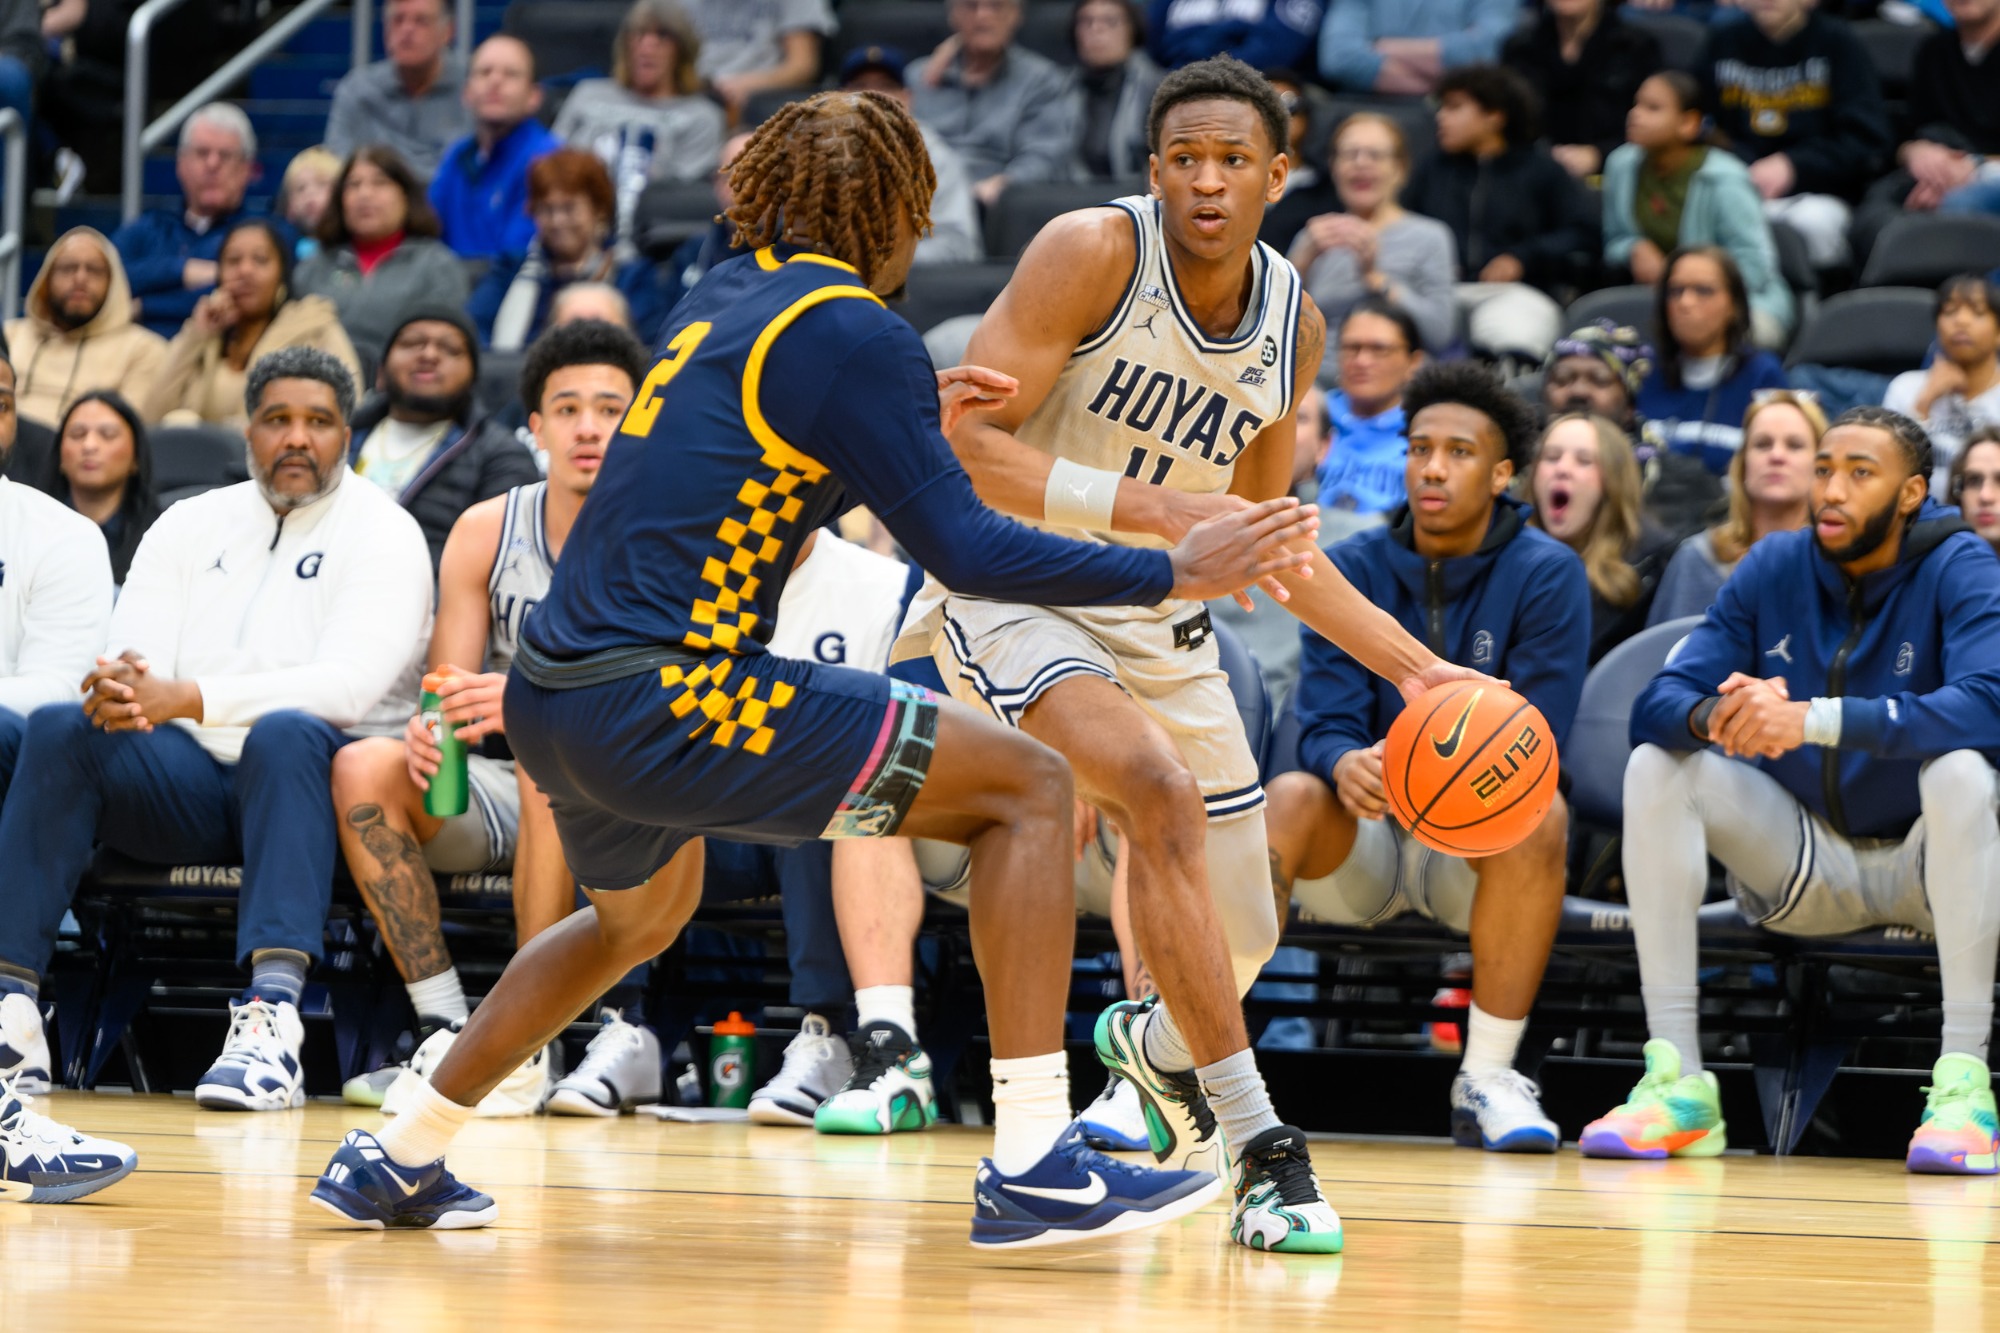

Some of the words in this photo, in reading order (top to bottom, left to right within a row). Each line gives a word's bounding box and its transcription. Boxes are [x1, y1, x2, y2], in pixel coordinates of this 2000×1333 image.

[1138, 291, 1170, 310] CHANGE
[1144, 285, 1157, 296] BE
[619, 321, 712, 438] 2
[1240, 372, 1267, 384] EAST
[1244, 366, 1265, 376] BIG
[1086, 356, 1264, 467] HOYAS
[295, 552, 324, 580] G
[814, 631, 846, 664] G
[1470, 725, 1541, 800] ELITE
[169, 865, 244, 886] HOYAS
[450, 874, 514, 893] HOYA
